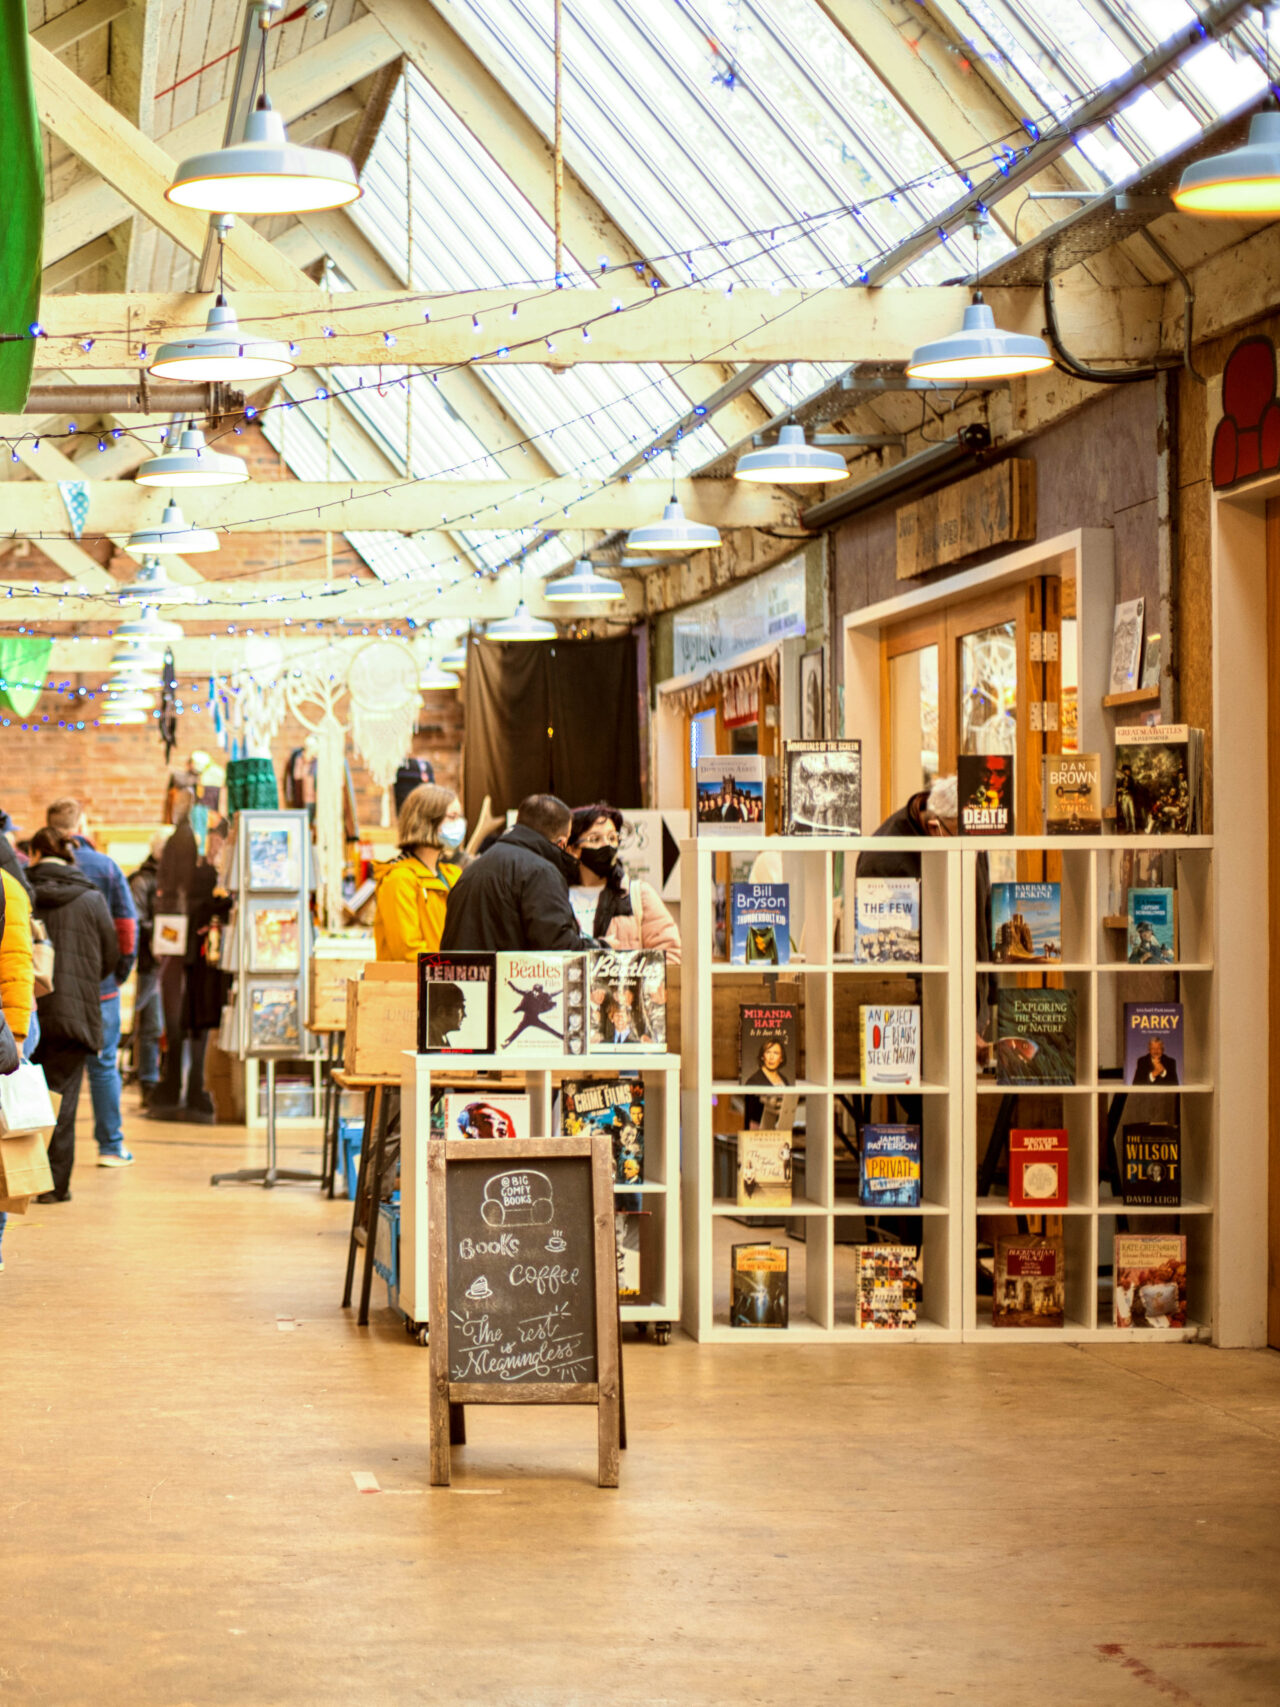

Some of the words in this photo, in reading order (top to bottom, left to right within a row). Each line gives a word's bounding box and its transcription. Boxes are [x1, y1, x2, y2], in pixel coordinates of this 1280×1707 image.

[827, 741, 837, 753] THE
[1061, 762, 1086, 771] DAN
[1050, 771, 1097, 785] BROWN
[963, 808, 1008, 825] DEATH
[753, 885, 772, 897] Bill
[1015, 884, 1052, 892] BARBARA
[737, 893, 786, 910] Bryson
[863, 902, 885, 914] THE
[889, 902, 913, 914] FEW
[425, 965, 490, 981] LENNON
[509, 960, 562, 979] Beatles
[591, 954, 662, 978] Beatles
[1014, 1000, 1067, 1012] EXPLORING
[744, 1009, 793, 1019] MIRANDA
[868, 1009, 881, 1022] AN
[884, 1008, 913, 1025] OBJECT
[1031, 1012, 1067, 1022] SECRETS
[754, 1019, 783, 1028] HART
[1029, 1022, 1064, 1033] NATURE
[1131, 1015, 1180, 1029] PARKY
[872, 1023, 890, 1050] OF
[892, 1025, 917, 1046] BEAUTY
[867, 1050, 890, 1065] STEVE
[892, 1047, 916, 1064] MARTIN
[573, 1091, 606, 1114] CRIME
[603, 1084, 633, 1108] FILMS
[878, 1135, 907, 1143] JAMES
[1127, 1135, 1140, 1143] THE
[867, 1142, 917, 1151] PATTERSON
[1126, 1143, 1178, 1161] WILSON
[871, 1159, 914, 1178] PRIVATE
[1126, 1163, 1178, 1181] PLOT
[500, 1185, 531, 1197] COMFY
[503, 1194, 532, 1207] BOOKS
[1126, 1195, 1152, 1204] DAVID
[1154, 1195, 1178, 1204] LEIGH
[509, 1264, 580, 1295] Coffee
[462, 1314, 504, 1346] The
[517, 1314, 560, 1344] rest
[500, 1341, 517, 1354] is
[457, 1340, 581, 1380] Meaningless
